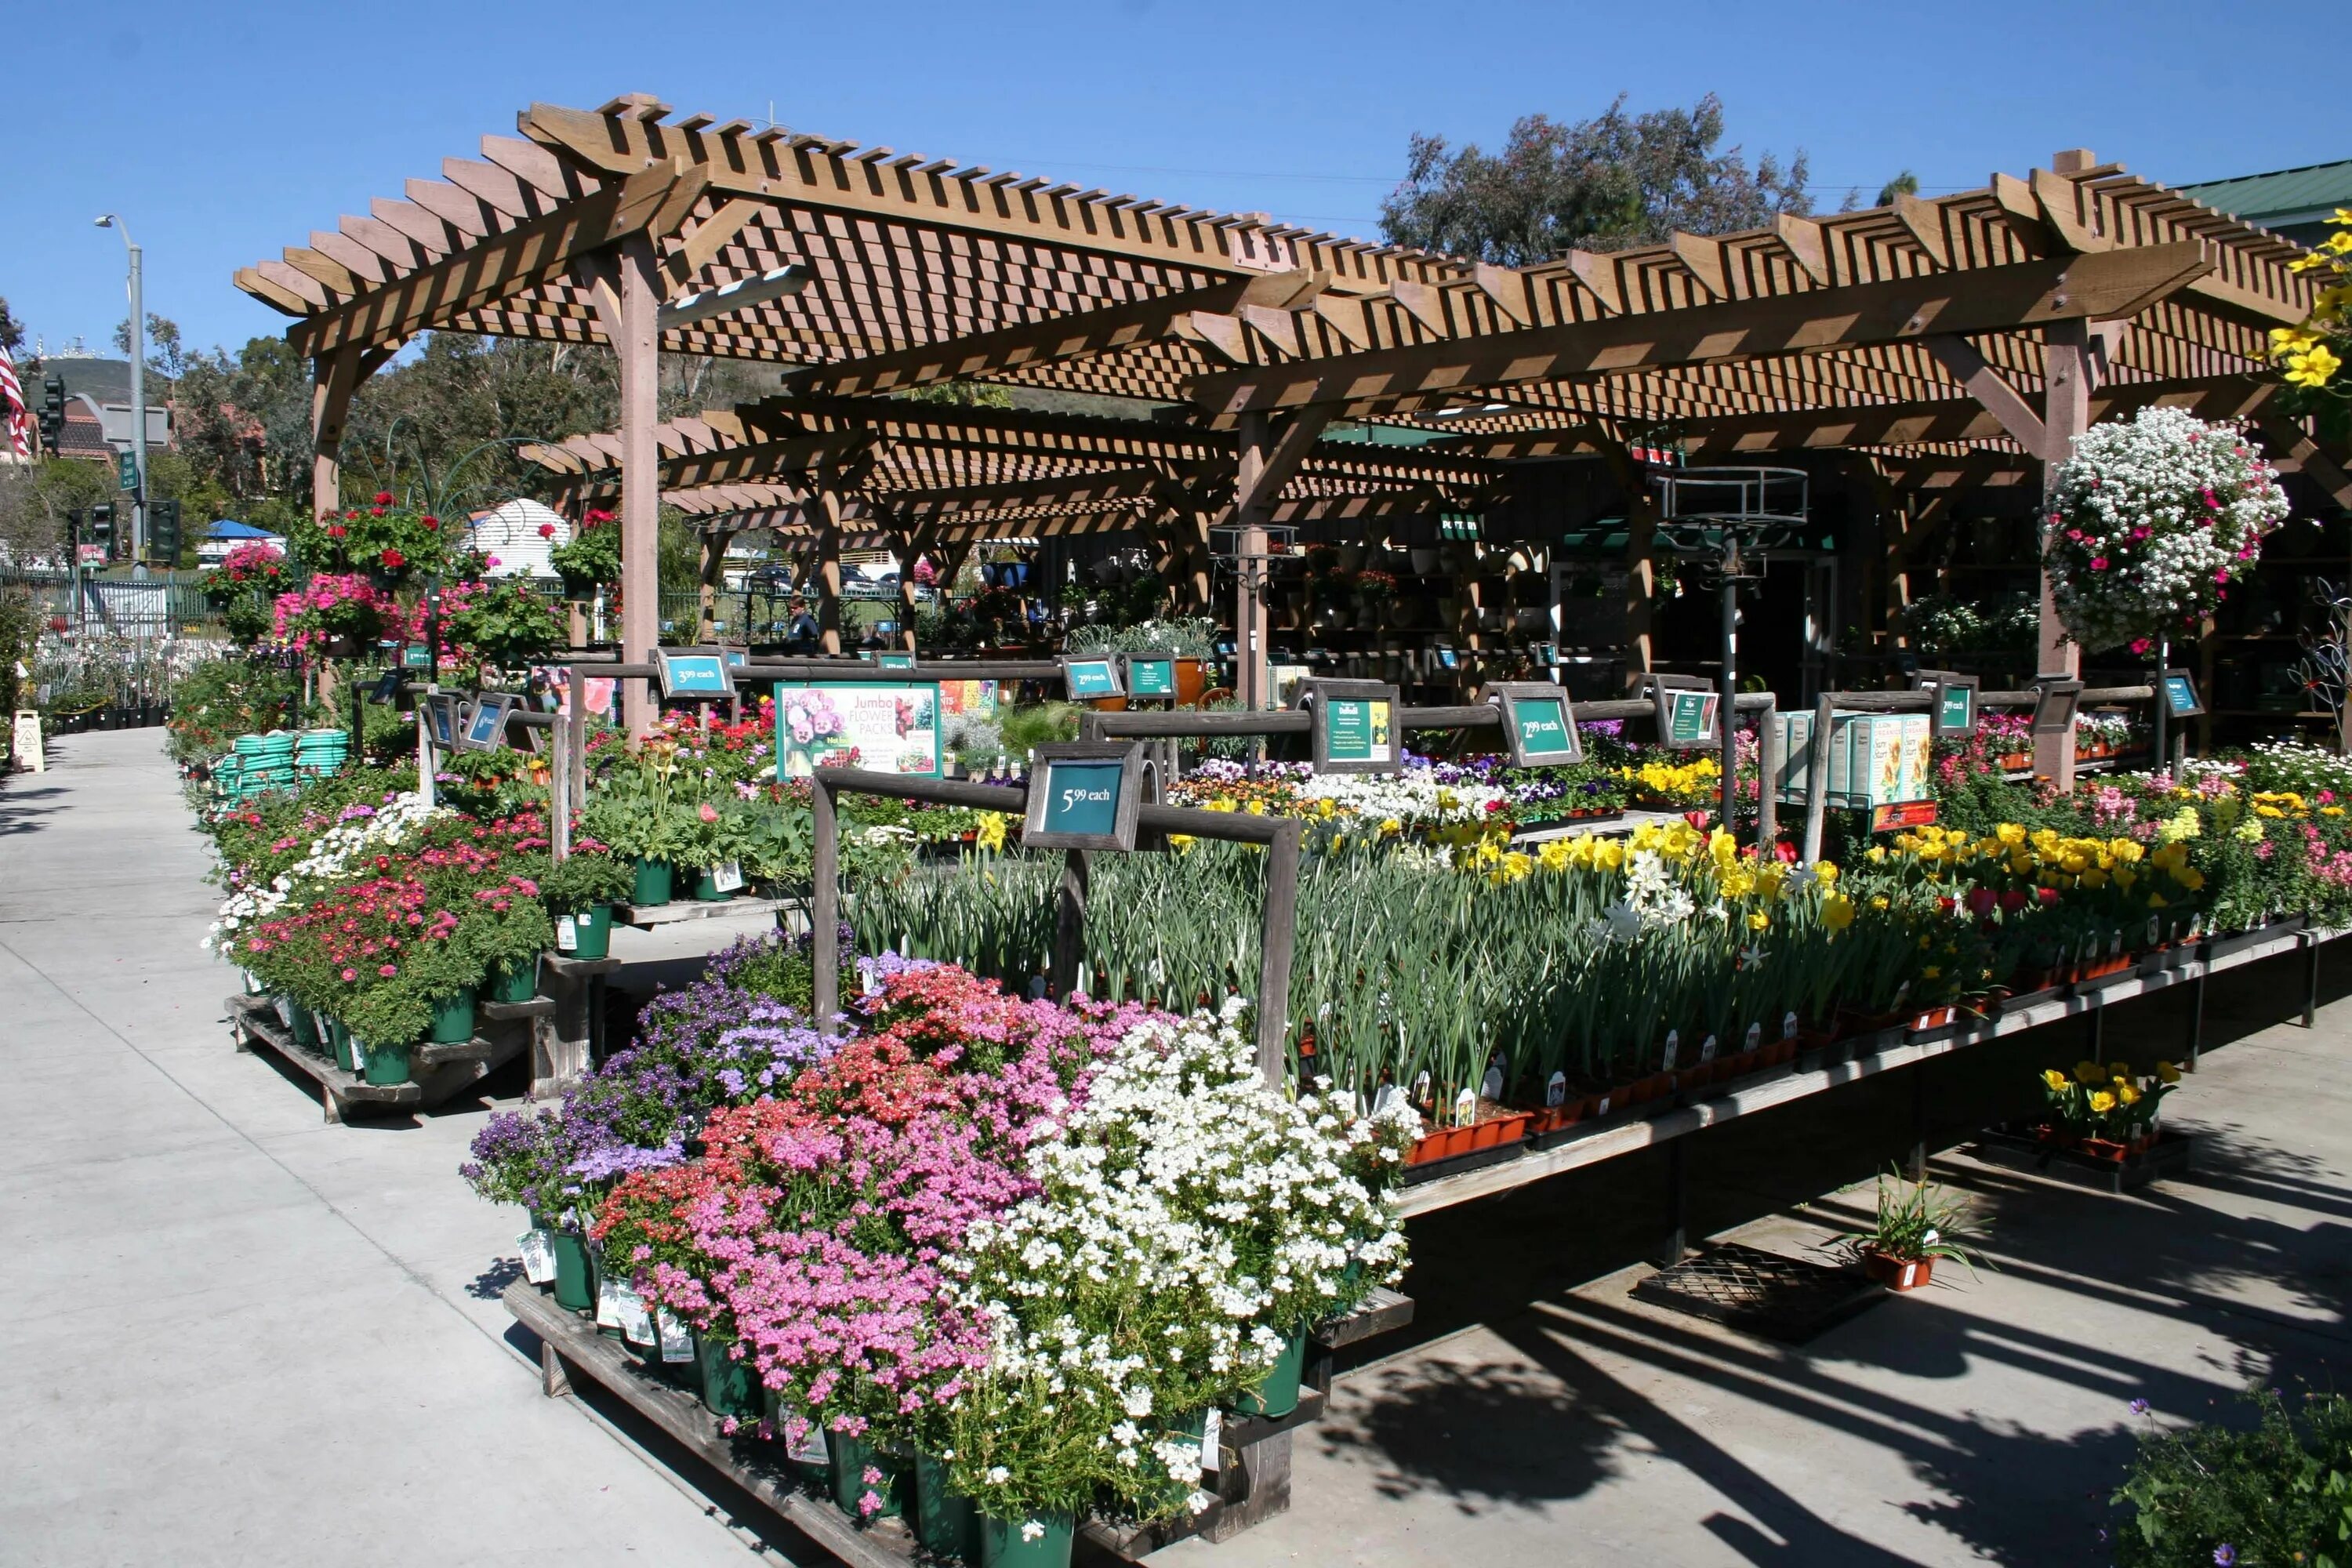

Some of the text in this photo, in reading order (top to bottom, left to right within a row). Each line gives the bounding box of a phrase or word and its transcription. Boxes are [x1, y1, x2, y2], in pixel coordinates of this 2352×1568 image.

[855, 694, 892, 708] Jumbo
[1953, 701, 1963, 710] each
[849, 710, 892, 721] FLOWER
[859, 723, 892, 734] PACKS
[1541, 720, 1559, 731] each
[1088, 789, 1110, 800] each
